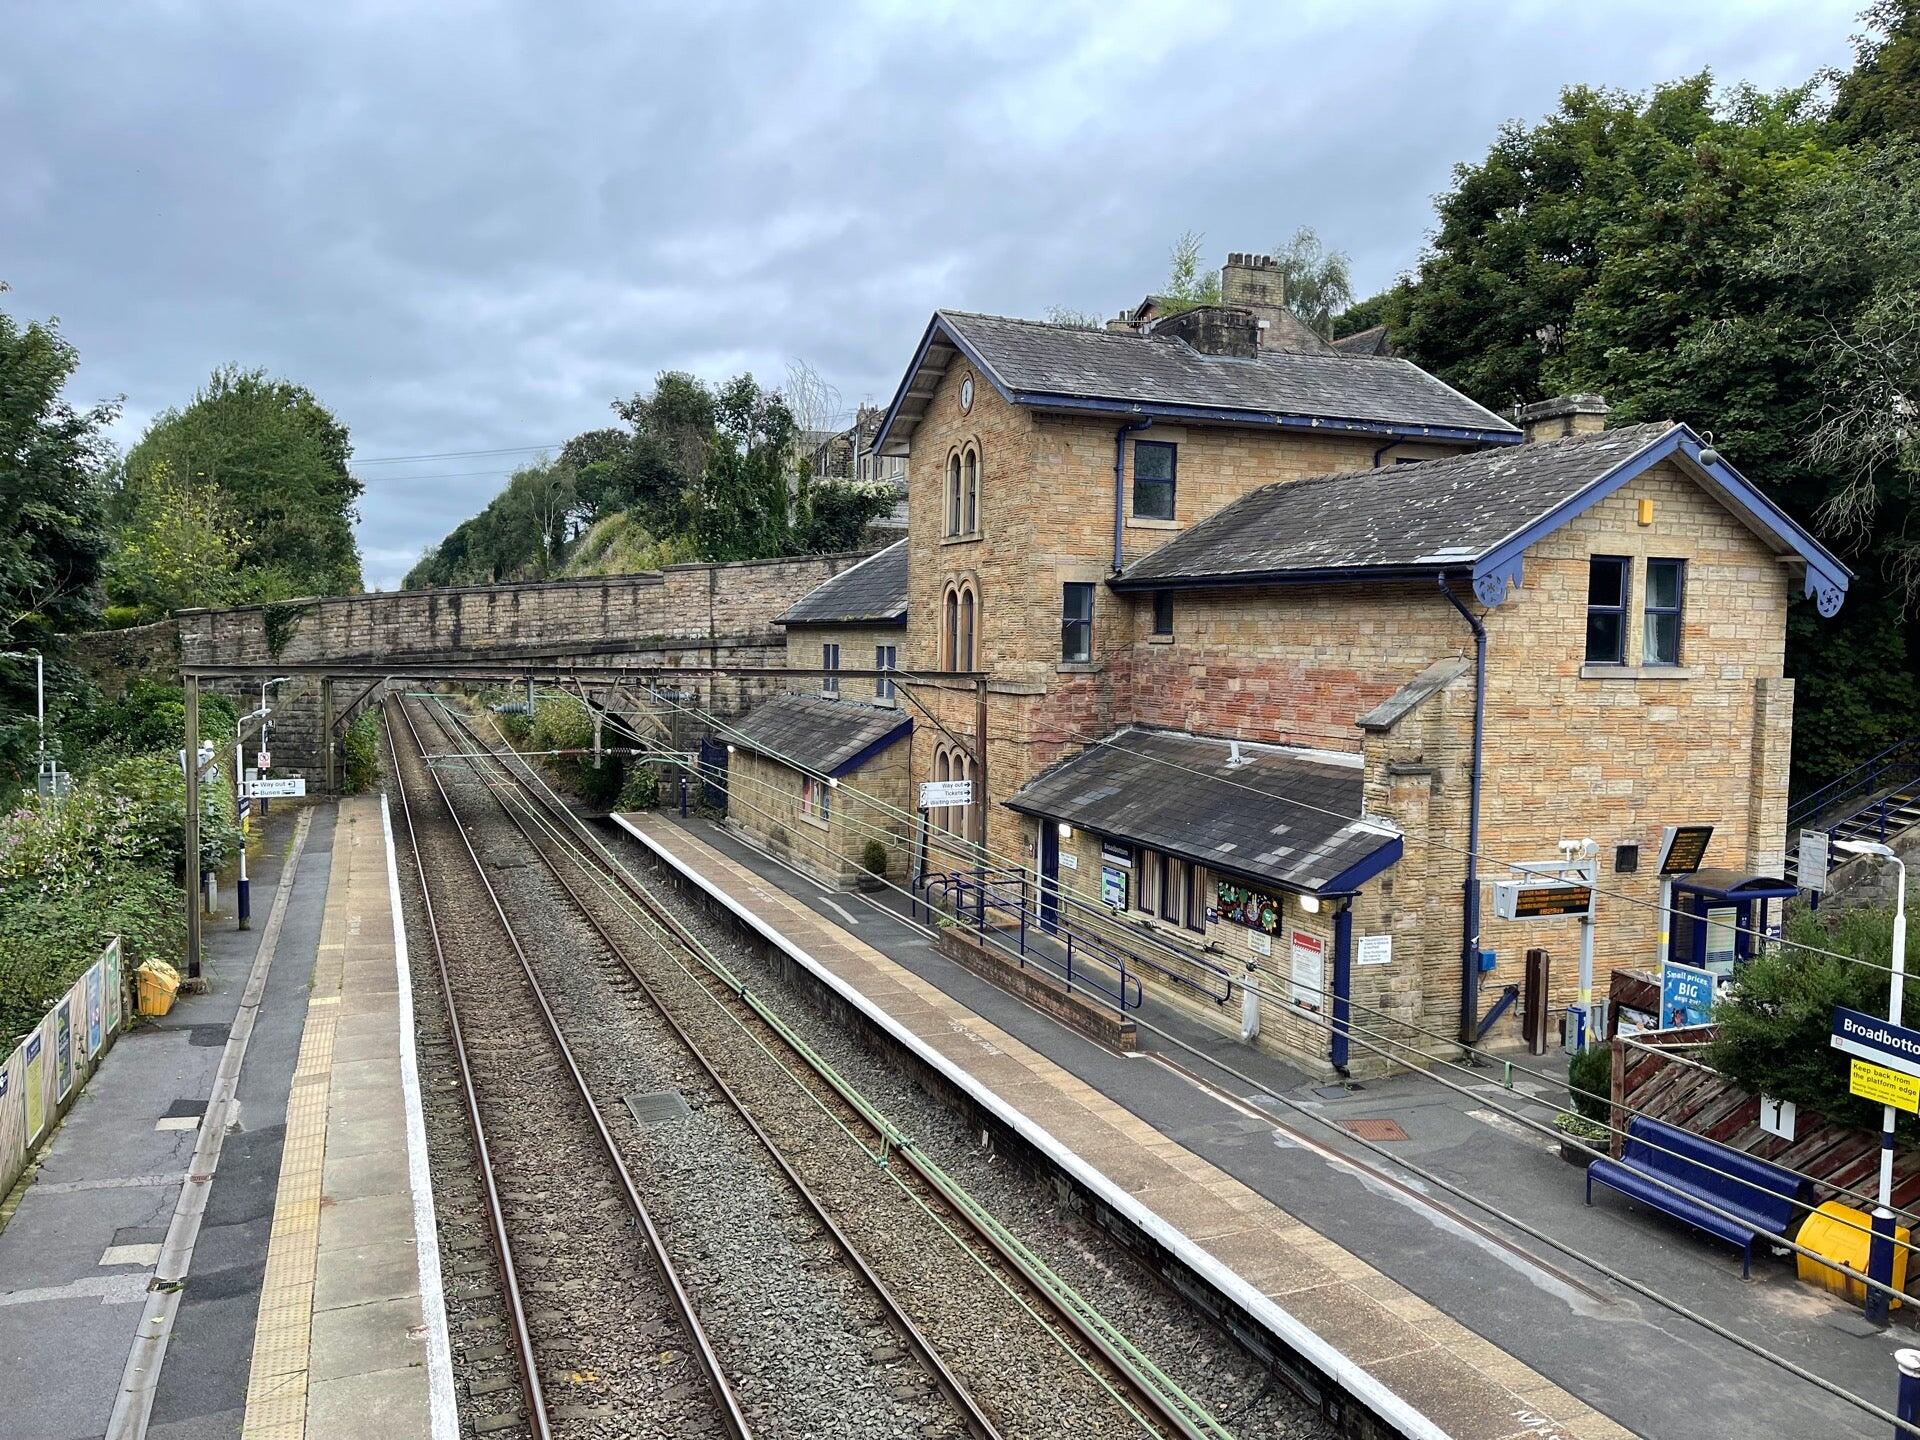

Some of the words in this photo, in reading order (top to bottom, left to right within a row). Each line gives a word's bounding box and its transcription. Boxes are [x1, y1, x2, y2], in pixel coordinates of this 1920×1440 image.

[1667, 971, 1686, 980] Small
[1687, 975, 1708, 985] prices
[1679, 982, 1698, 997] BIG
[1853, 1063, 1871, 1074] Keep
[1873, 1070, 1891, 1080] back
[1893, 1075, 1911, 1086] from
[1853, 1072, 1864, 1081] the
[1867, 1077, 1897, 1089] platform
[1898, 1086, 1917, 1097] edge
